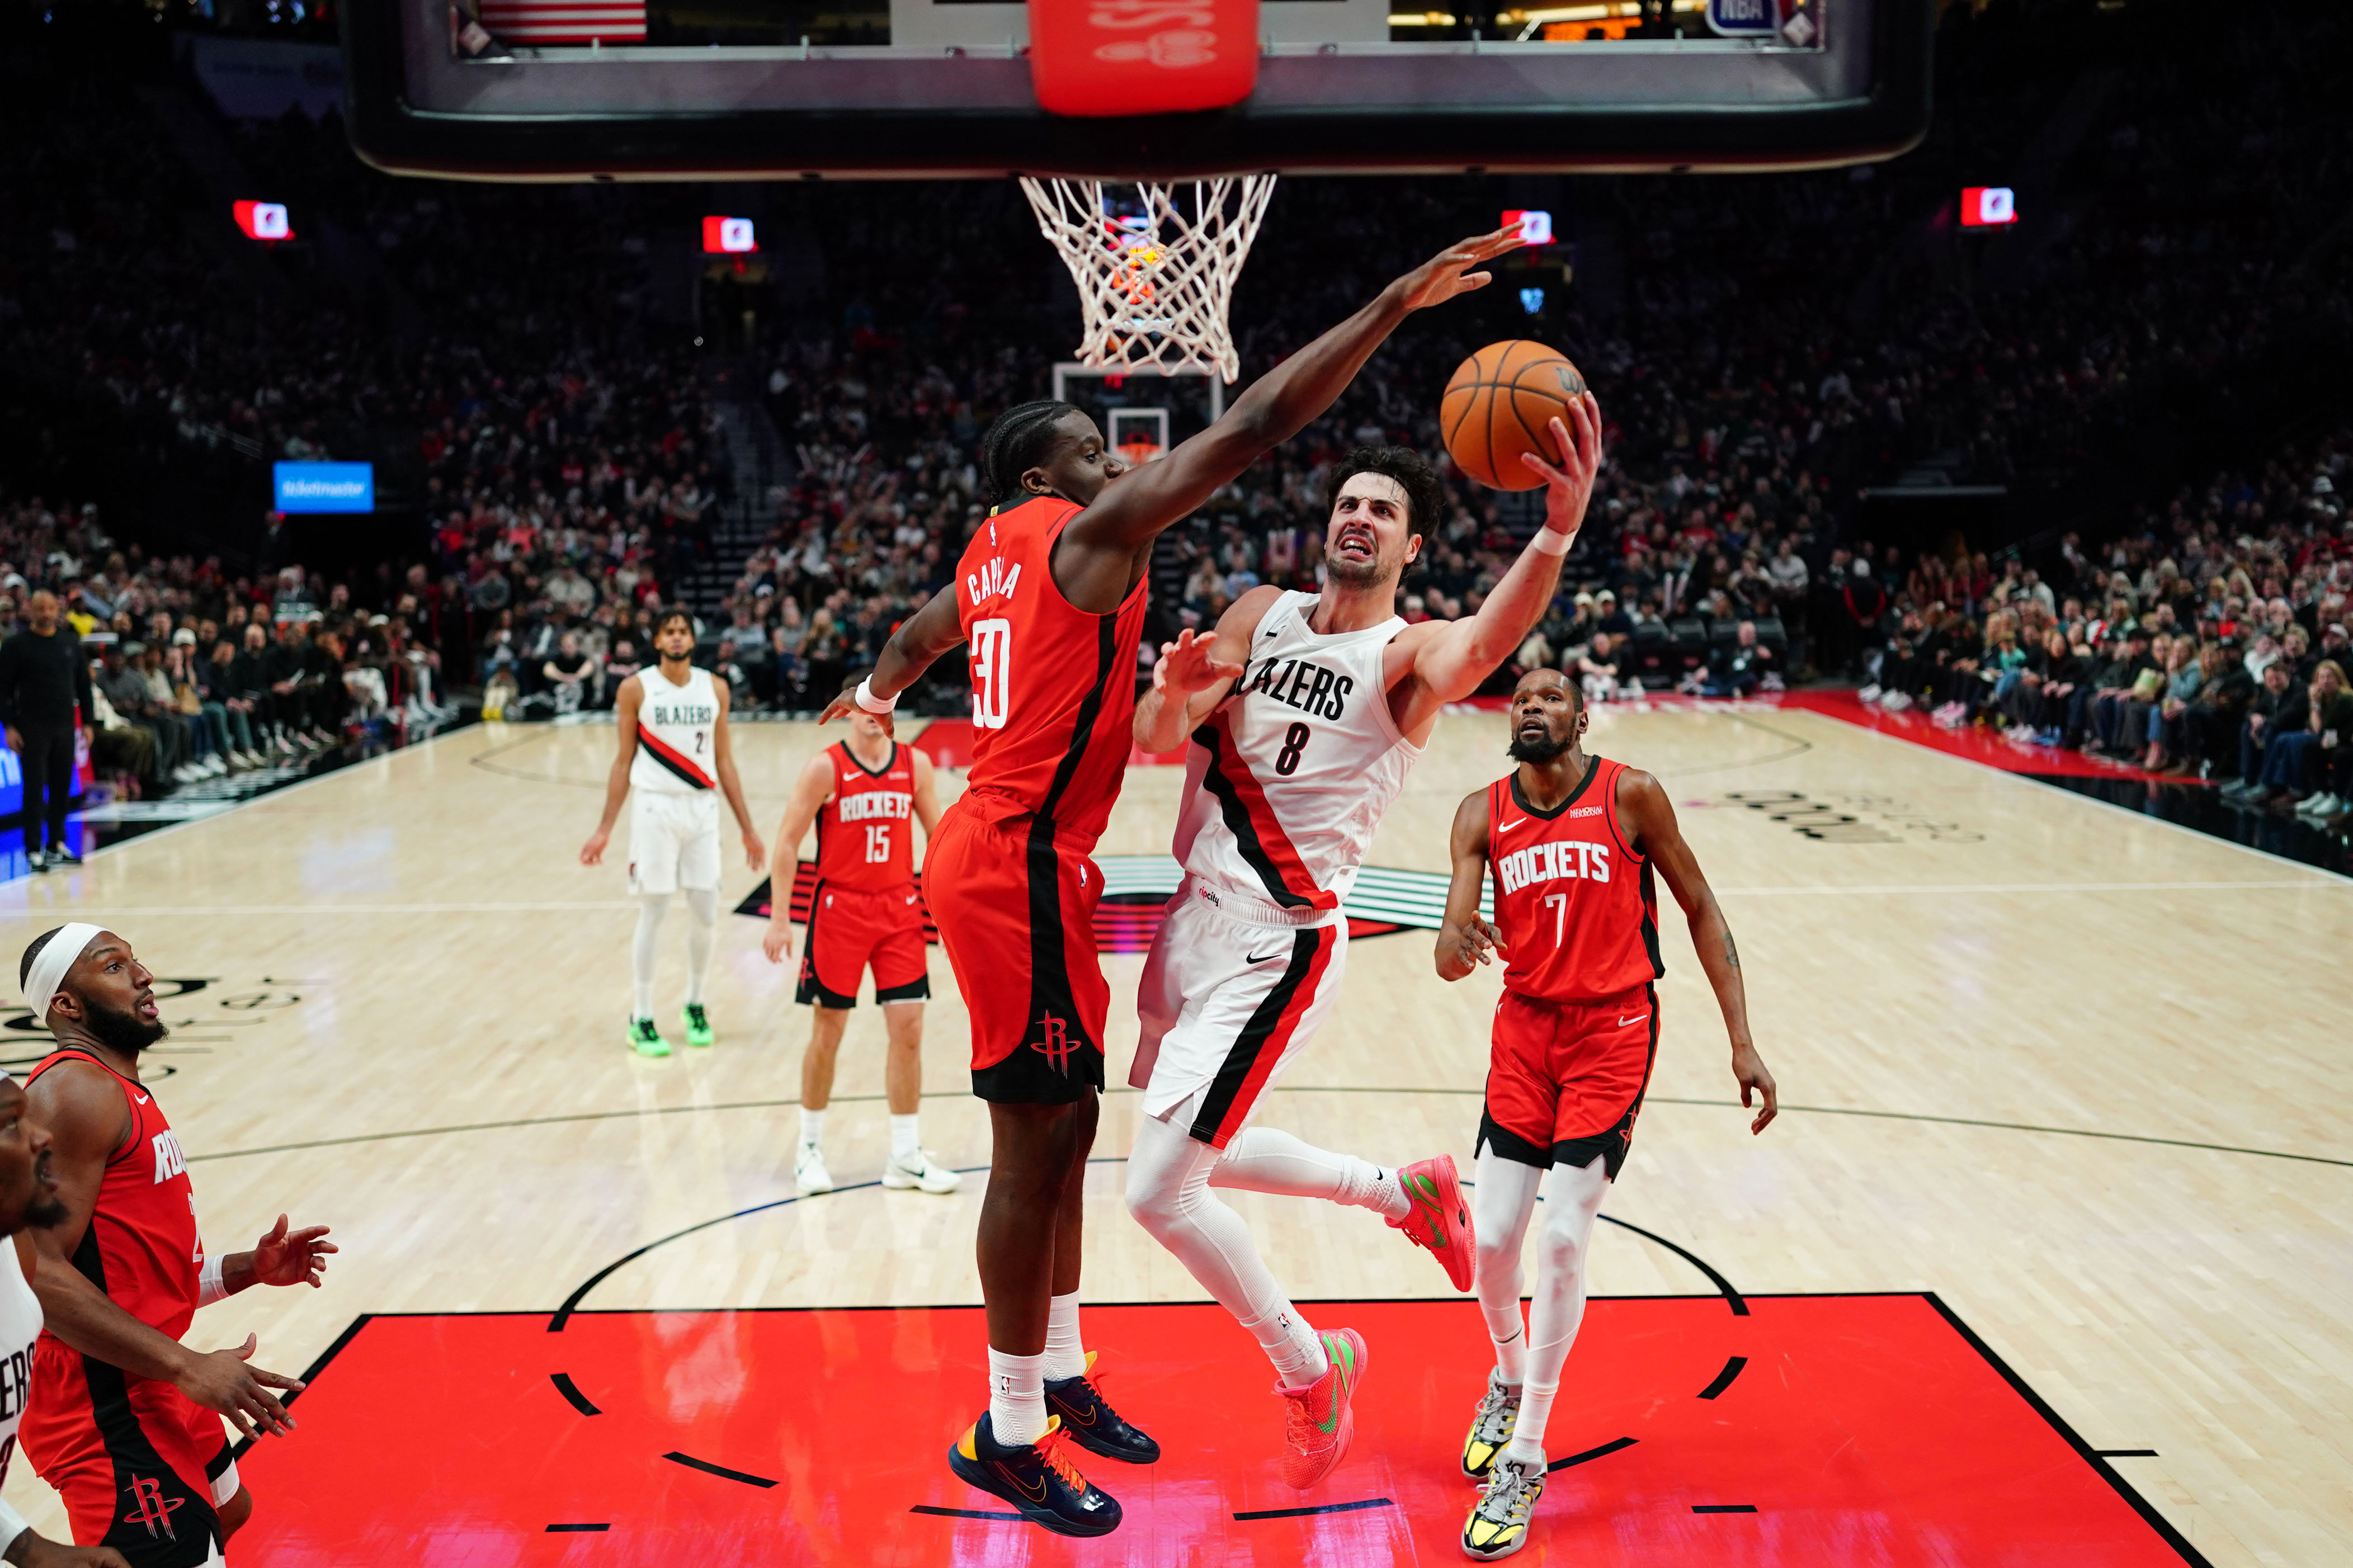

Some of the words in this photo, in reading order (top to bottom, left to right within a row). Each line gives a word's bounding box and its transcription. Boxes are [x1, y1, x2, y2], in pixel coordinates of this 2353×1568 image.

[1225, 657, 1354, 721] LAZERS
[654, 706, 711, 725] BLAZERS
[1275, 722, 1310, 776] 8
[840, 791, 913, 823] ROCKETS
[1570, 805, 1603, 815] MEMORIAL
[1570, 809, 1603, 819] HERMANN
[865, 825, 890, 863] 15
[1498, 840, 1609, 896] ROCKETS
[1544, 893, 1566, 948] 7
